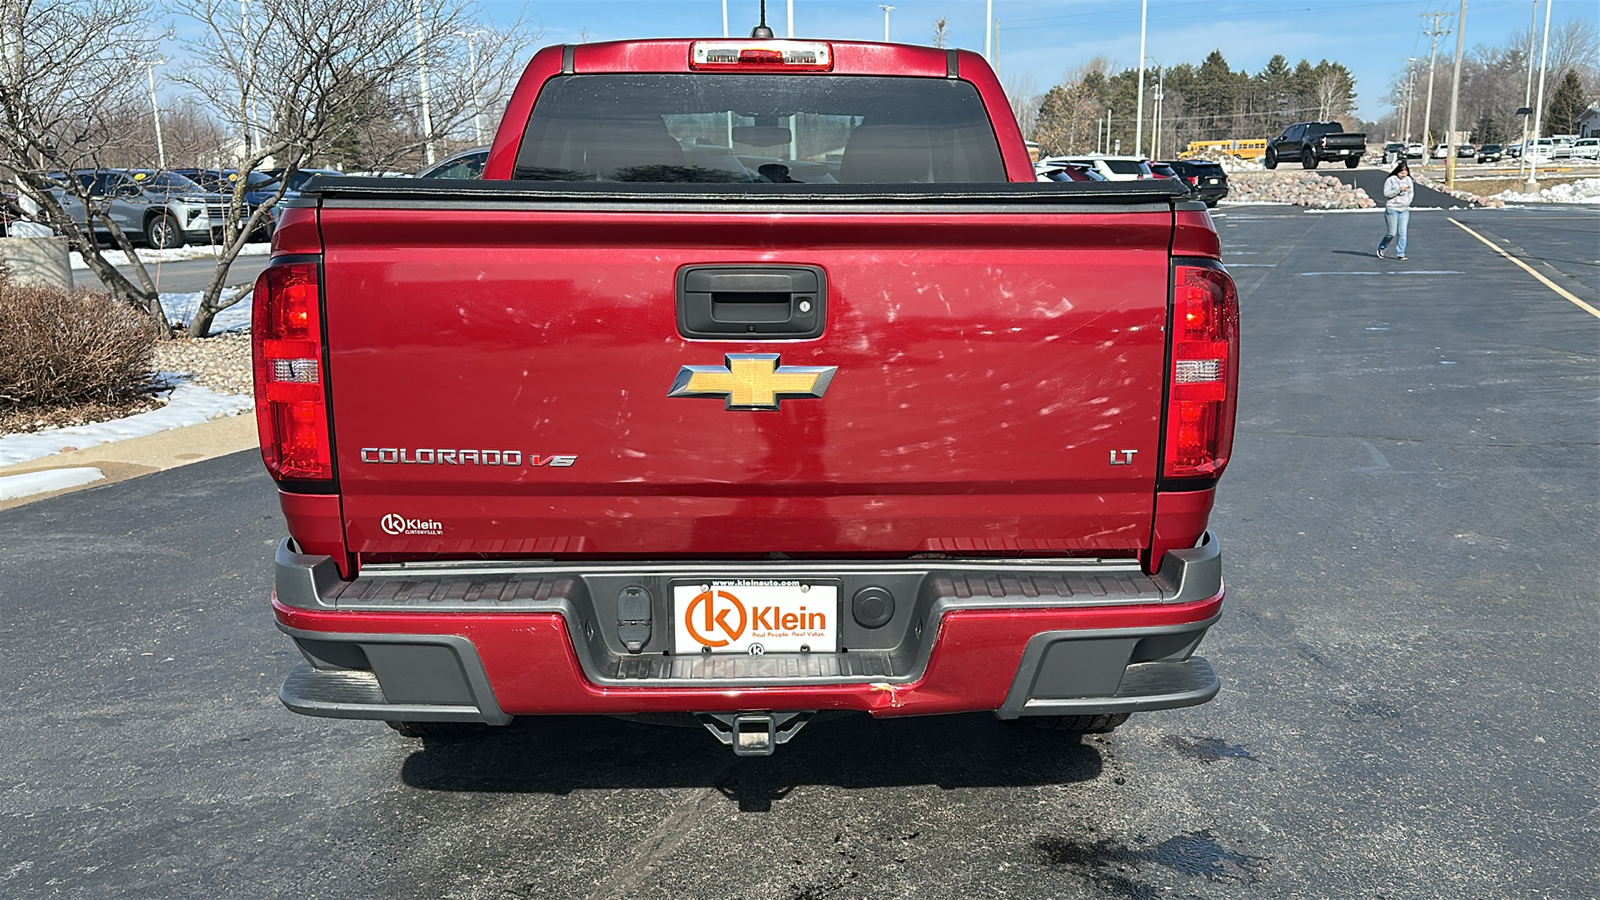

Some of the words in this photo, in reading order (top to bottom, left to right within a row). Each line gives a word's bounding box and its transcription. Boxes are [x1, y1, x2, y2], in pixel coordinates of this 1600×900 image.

[360, 447, 522, 466] COLORADO
[530, 455, 578, 467] V6
[1109, 449, 1138, 466] LT
[406, 519, 442, 530] Klein
[752, 606, 826, 631] Klein
